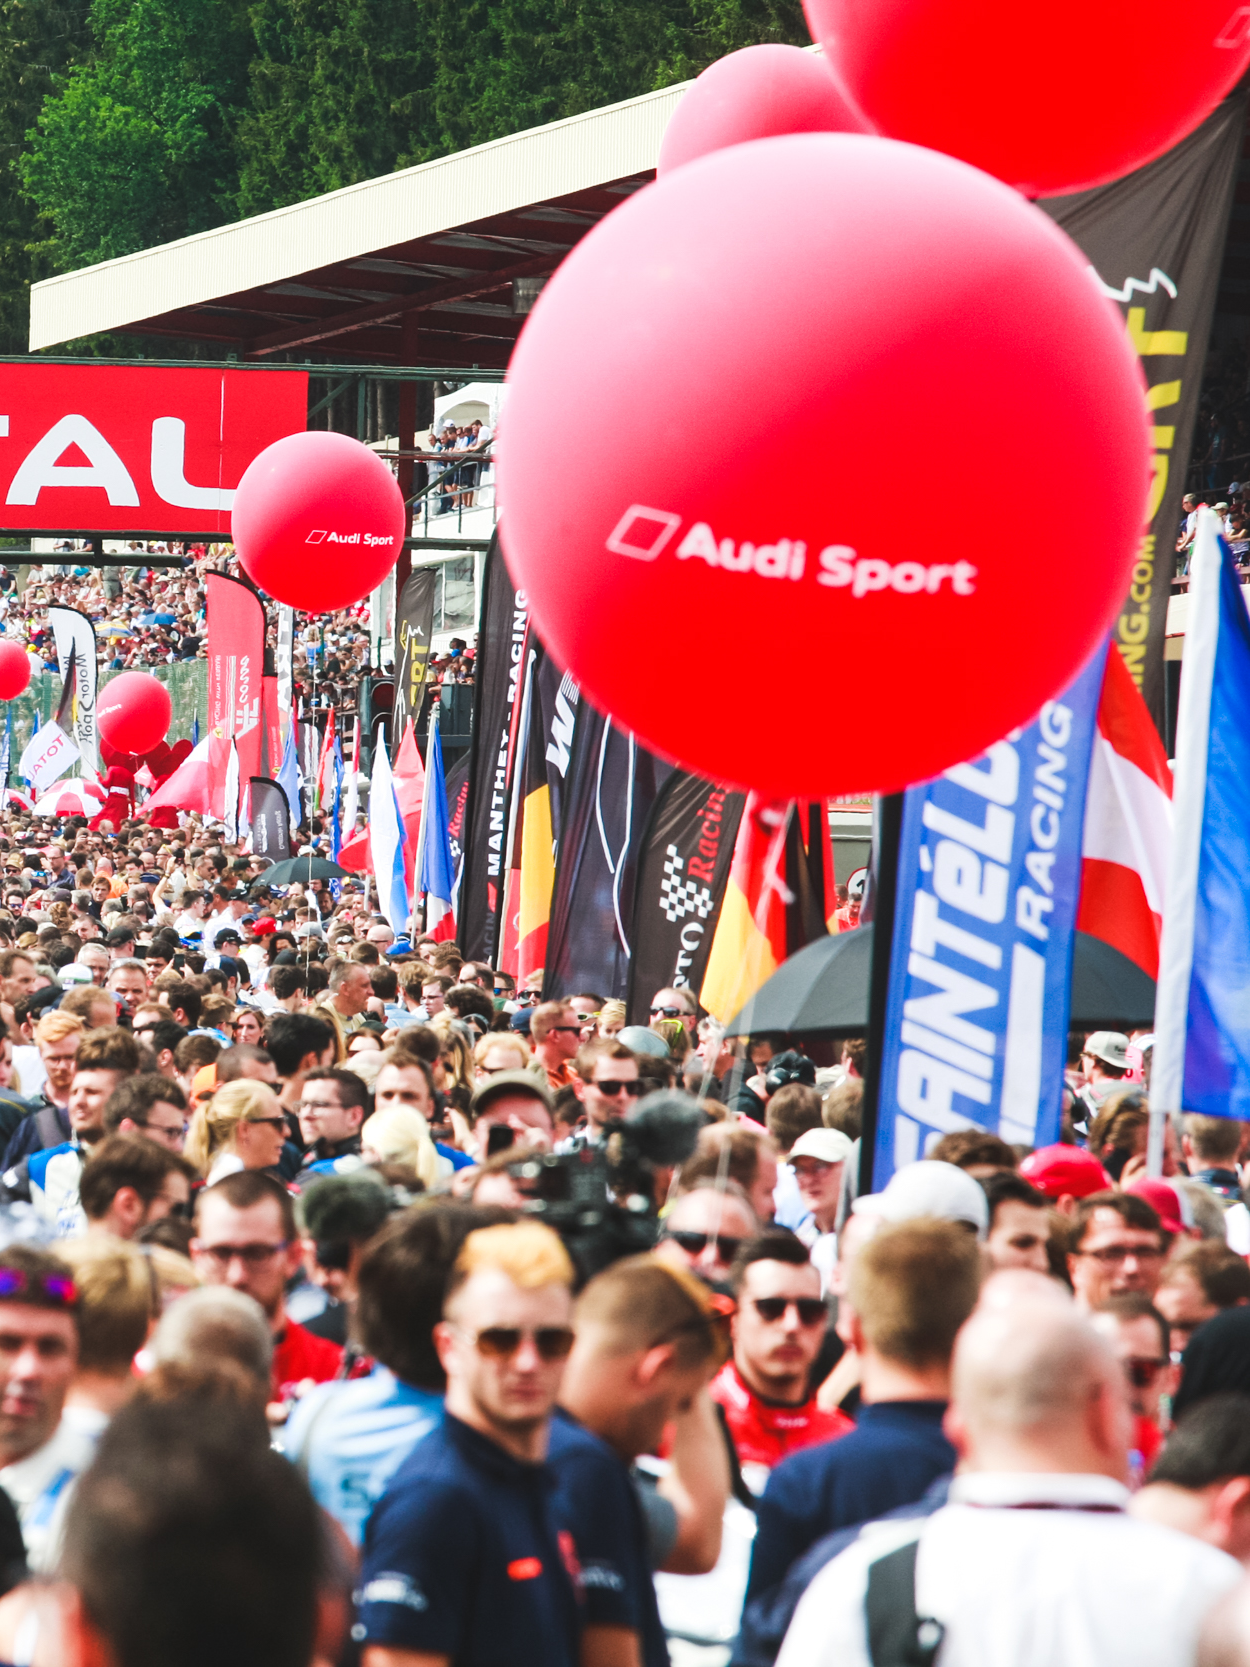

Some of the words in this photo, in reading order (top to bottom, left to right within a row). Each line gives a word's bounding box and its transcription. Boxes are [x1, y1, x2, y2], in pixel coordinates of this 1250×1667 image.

[327, 532, 361, 544] Audi
[363, 533, 394, 547] Sport
[676, 521, 807, 581] Audi
[817, 544, 978, 598] Sport
[488, 729, 510, 877] MANTHEY
[507, 588, 530, 703] RACING
[688, 781, 730, 884] Racin
[1014, 698, 1073, 942] RACING
